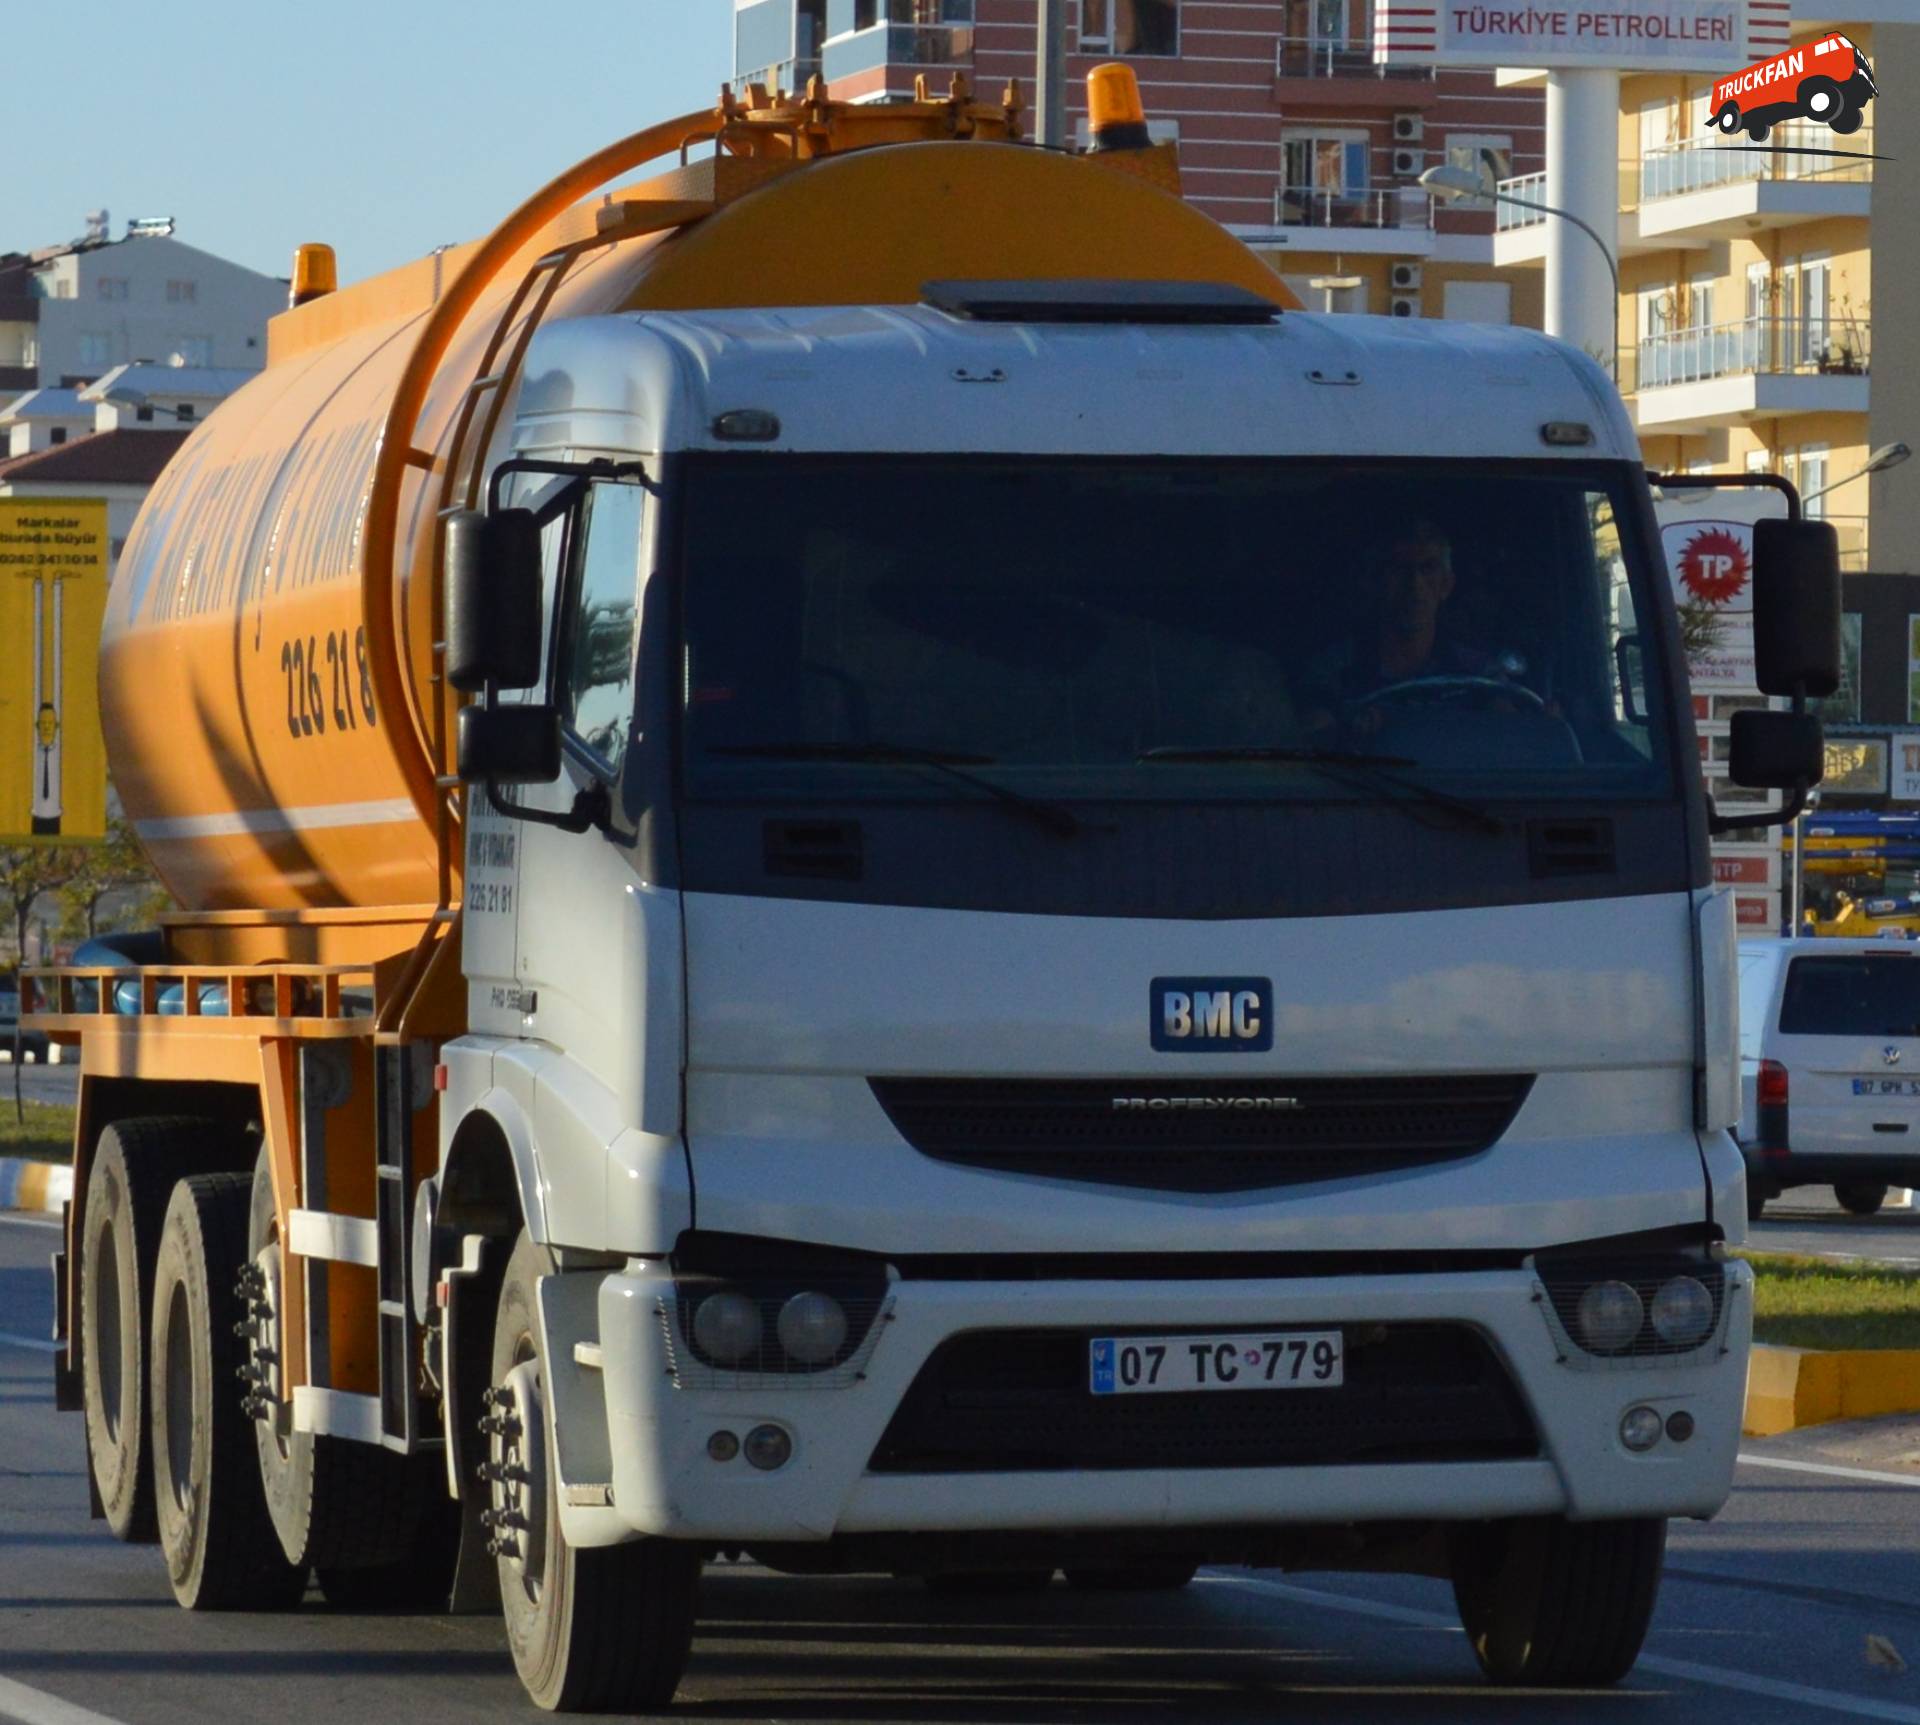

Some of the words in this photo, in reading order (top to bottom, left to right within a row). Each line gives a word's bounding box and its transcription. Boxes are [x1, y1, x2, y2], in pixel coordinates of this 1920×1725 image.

[1453, 7, 1567, 36] TÜRKİYE
[1577, 13, 1733, 42] PETROLLERİ
[1697, 554, 1734, 579] TP
[281, 635, 326, 739] 226
[327, 630, 357, 732] 21
[1163, 990, 1260, 1039] BMC
[1120, 1346, 1166, 1386] 07
[1189, 1343, 1239, 1383] TC
[1262, 1340, 1338, 1380] 779
